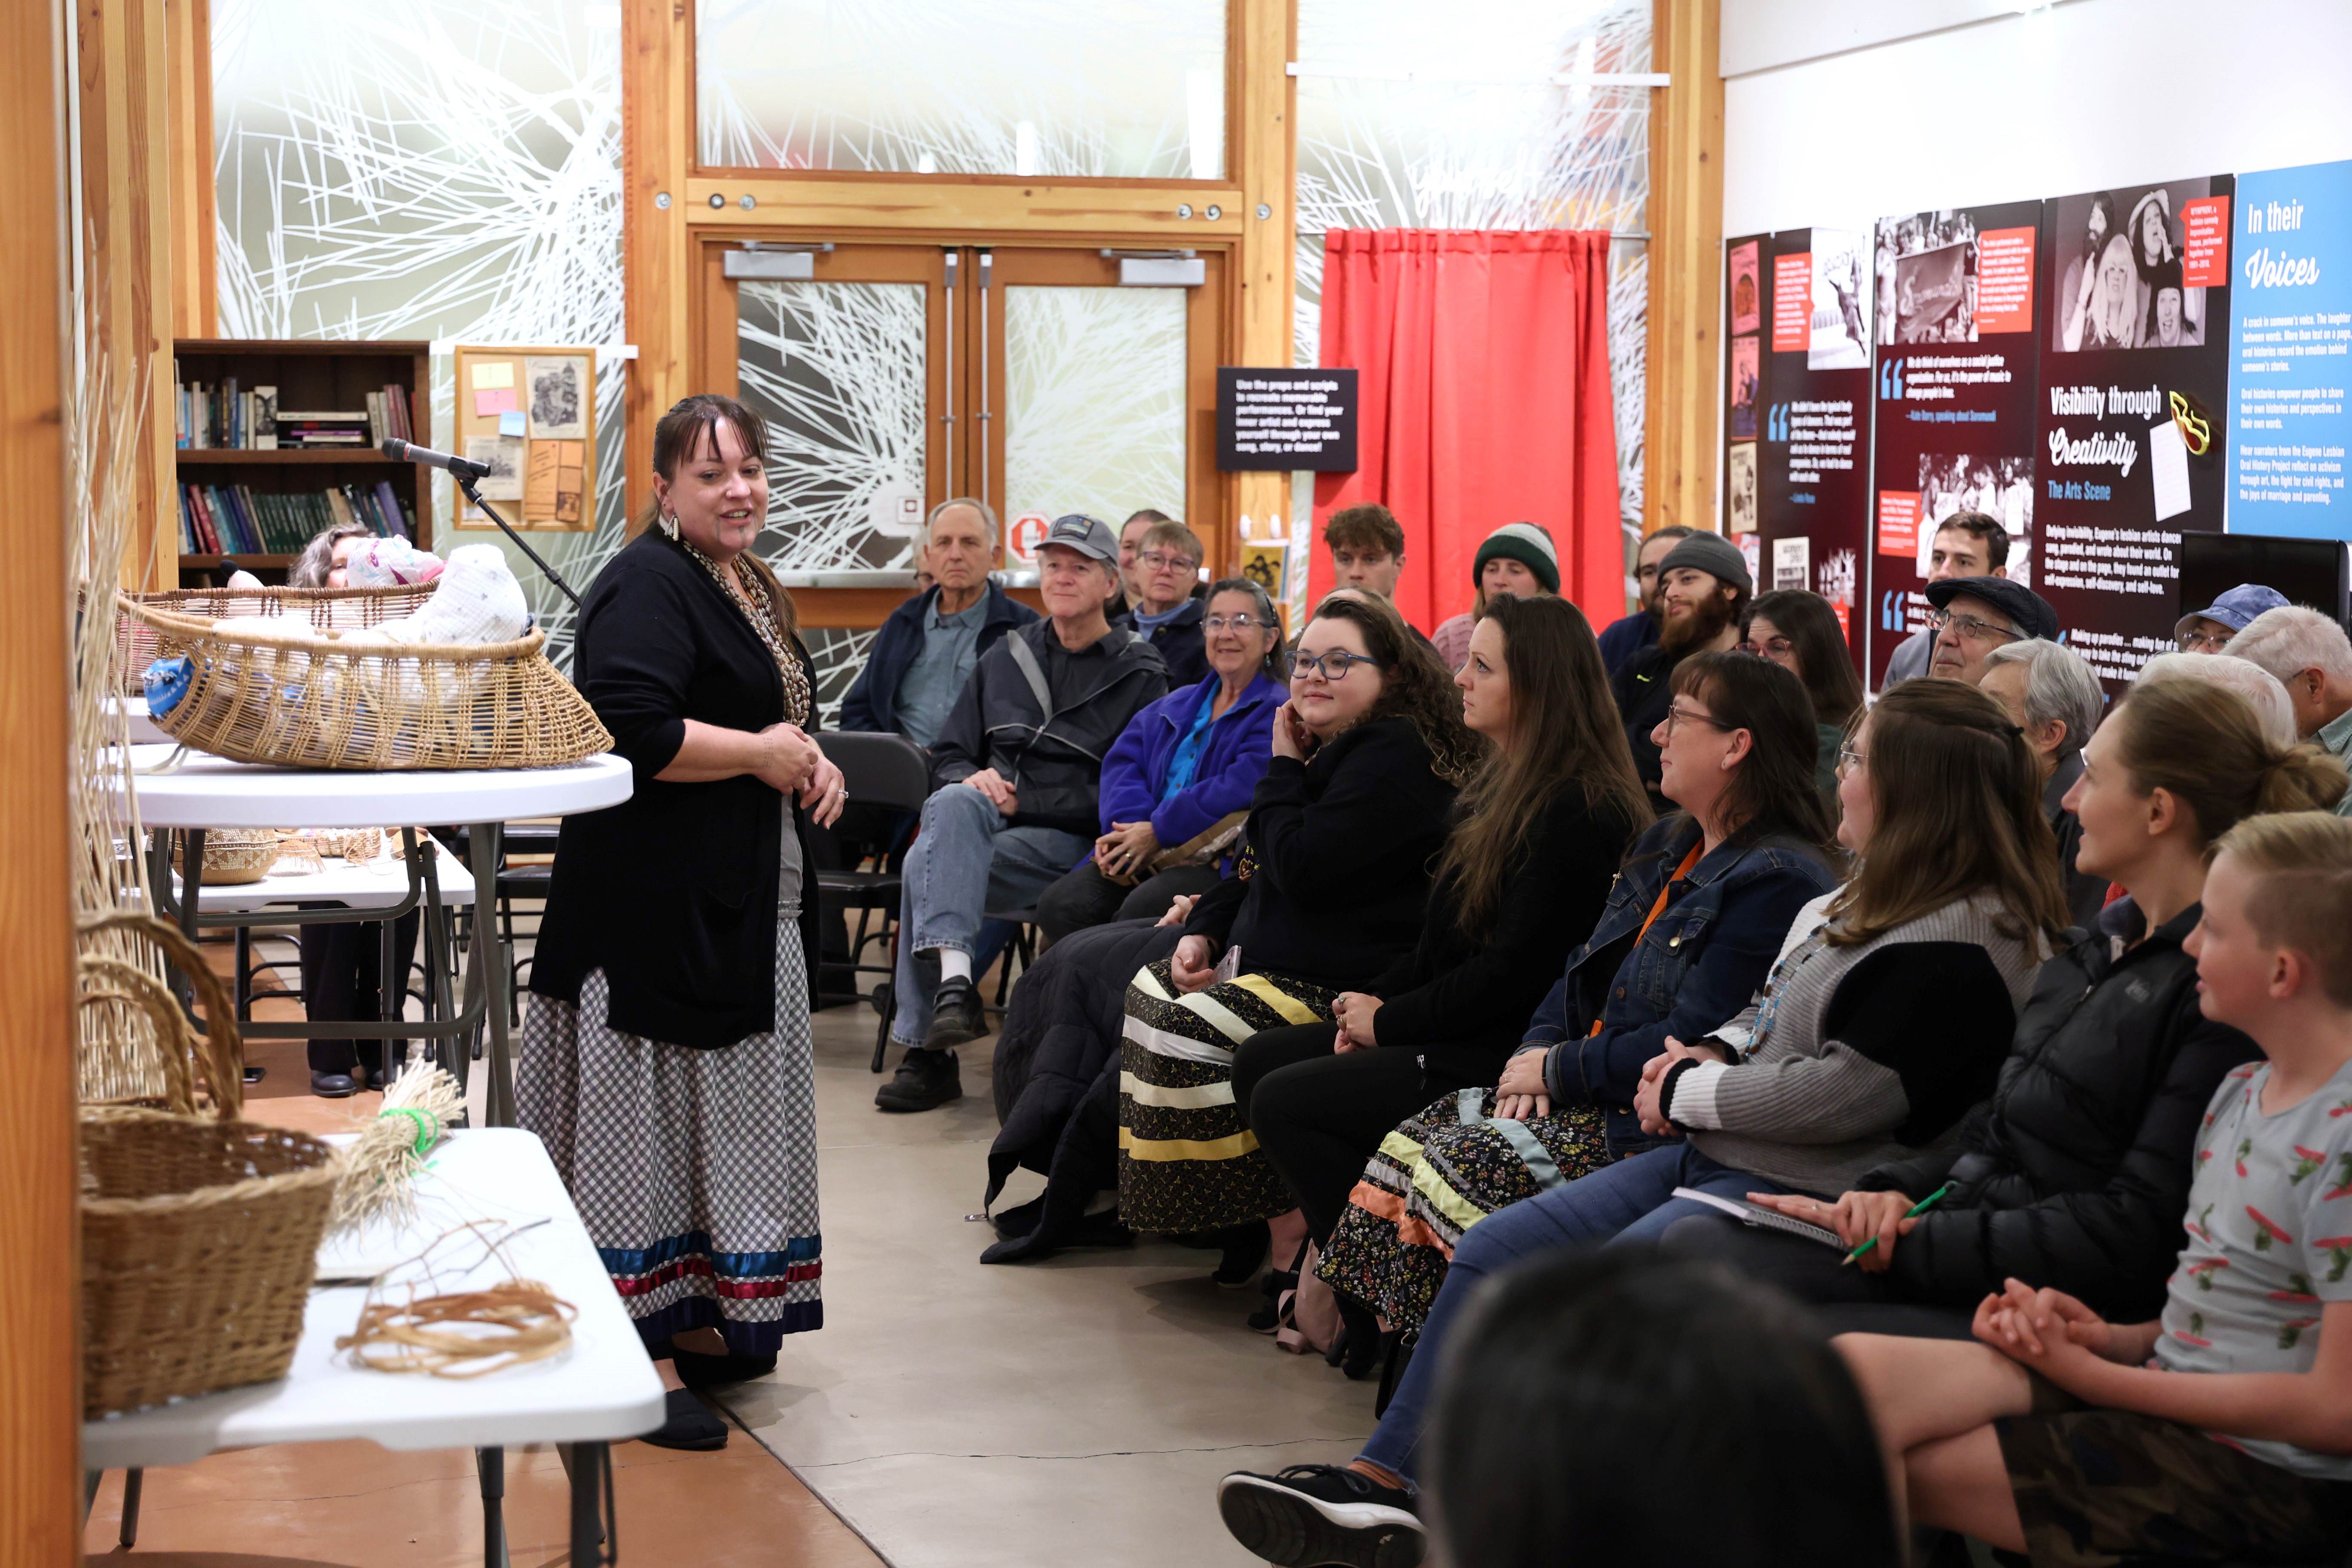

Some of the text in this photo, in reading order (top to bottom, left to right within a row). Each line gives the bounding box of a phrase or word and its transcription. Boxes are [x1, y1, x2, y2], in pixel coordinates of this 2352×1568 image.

[2248, 199, 2303, 234] In their
[2245, 248, 2320, 289] Voices
[2243, 312, 2351, 328] A crack in someone's voice. The laughter
[2243, 329, 2352, 343] between words. More than text on a page,
[2242, 343, 2347, 358] oral histories record the emotion behind
[2242, 361, 2290, 372] someone's stories.
[1236, 380, 1253, 390] Use
[1253, 380, 1268, 390] the
[1268, 382, 1293, 392] props
[1292, 380, 1310, 390] and
[1236, 392, 1246, 402] to
[2241, 387, 2344, 401] Oral histories empower people to share
[2051, 384, 2161, 420] Visibility through
[2241, 402, 2341, 416] their own histories and perspectives in
[1295, 404, 1307, 415] Or
[1306, 405, 1324, 415] find
[1324, 407, 1344, 417] your
[1258, 417, 1281, 427] artist
[1281, 417, 1298, 427] and
[1298, 416, 1331, 429] express
[2241, 418, 2283, 429] their own words.
[1236, 428, 1340, 441] yourself through your own
[1283, 441, 1293, 452] or
[2049, 427, 2138, 477] Creativity
[2240, 445, 2345, 459] Hear narrators from the Eugene Lesbian
[2240, 459, 2341, 473] Oral History Project reflect on activism
[2240, 474, 2260, 487] through
[2260, 475, 2270, 486] art,
[2271, 475, 2279, 486] the
[2280, 475, 2292, 488] fight
[2302, 476, 2314, 487] civil
[2315, 476, 2332, 490] rights,
[2334, 477, 2344, 488] and
[2048, 480, 2110, 500] The Arts Scene
[2240, 489, 2331, 505] the joys of marriage and parenting.
[2046, 524, 2066, 540] Defying
[2095, 527, 2119, 542] Eugene's
[2120, 528, 2141, 542] lesbian
[2141, 530, 2160, 543] artists
[2085, 544, 2096, 556] and
[2096, 545, 2112, 557] wrote
[2113, 545, 2129, 558] about
[2128, 546, 2143, 559] their
[2144, 547, 2162, 560] world.
[2163, 547, 2172, 560] On
[2045, 557, 2179, 579] the stage and on the page, they found an outlet for
[2125, 580, 2137, 592] and
[2137, 581, 2164, 594] self-love.
[2071, 628, 2091, 646] Making
[2091, 634, 2099, 646] up
[2098, 633, 2124, 646] parodies
[2132, 636, 2154, 652] making
[2155, 637, 2165, 652] fun
[2165, 639, 2174, 653] of
[2091, 648, 2098, 660] to
[2098, 649, 2111, 662] take
[2111, 650, 2121, 663] the
[2121, 651, 2136, 666] sting
[2100, 665, 2117, 679] make
[2117, 667, 2123, 680] it
